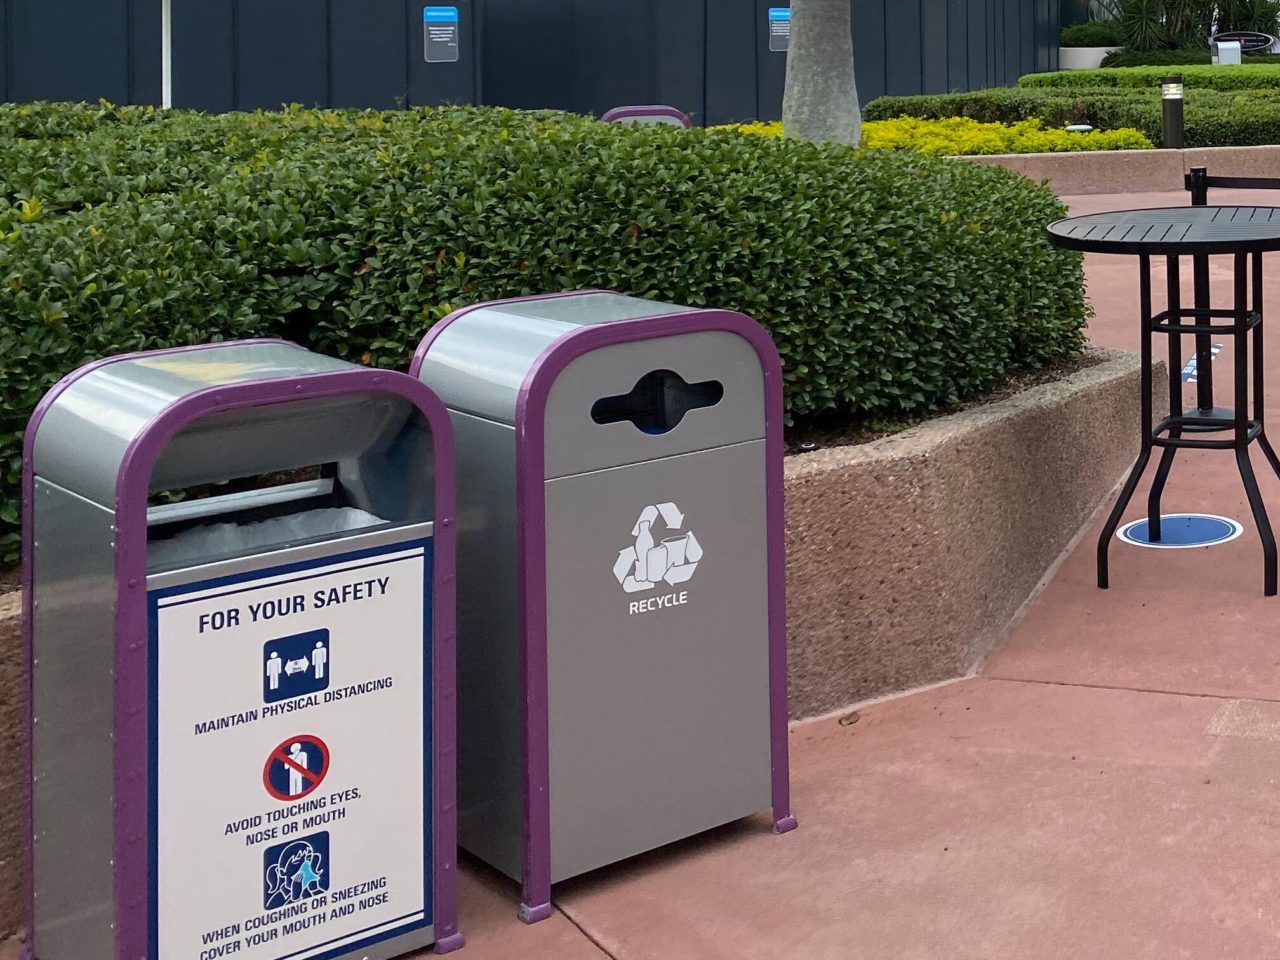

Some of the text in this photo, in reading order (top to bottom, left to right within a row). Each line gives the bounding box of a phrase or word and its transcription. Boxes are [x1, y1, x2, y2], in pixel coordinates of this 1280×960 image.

[198, 576, 390, 634] FOR YOUR SAFETY
[629, 591, 688, 615] RECYCLE
[194, 676, 393, 735] MAINTAIN PHYSICAL DISTANCING
[224, 787, 362, 835] AVOID TOUCHING EYES,
[245, 807, 346, 846] NOSE OR MOUTH
[199, 891, 389, 960] COVER YOUR MOUTH AND NOSE
[201, 876, 387, 945] WHEN COUGHING OR SNEEZING
